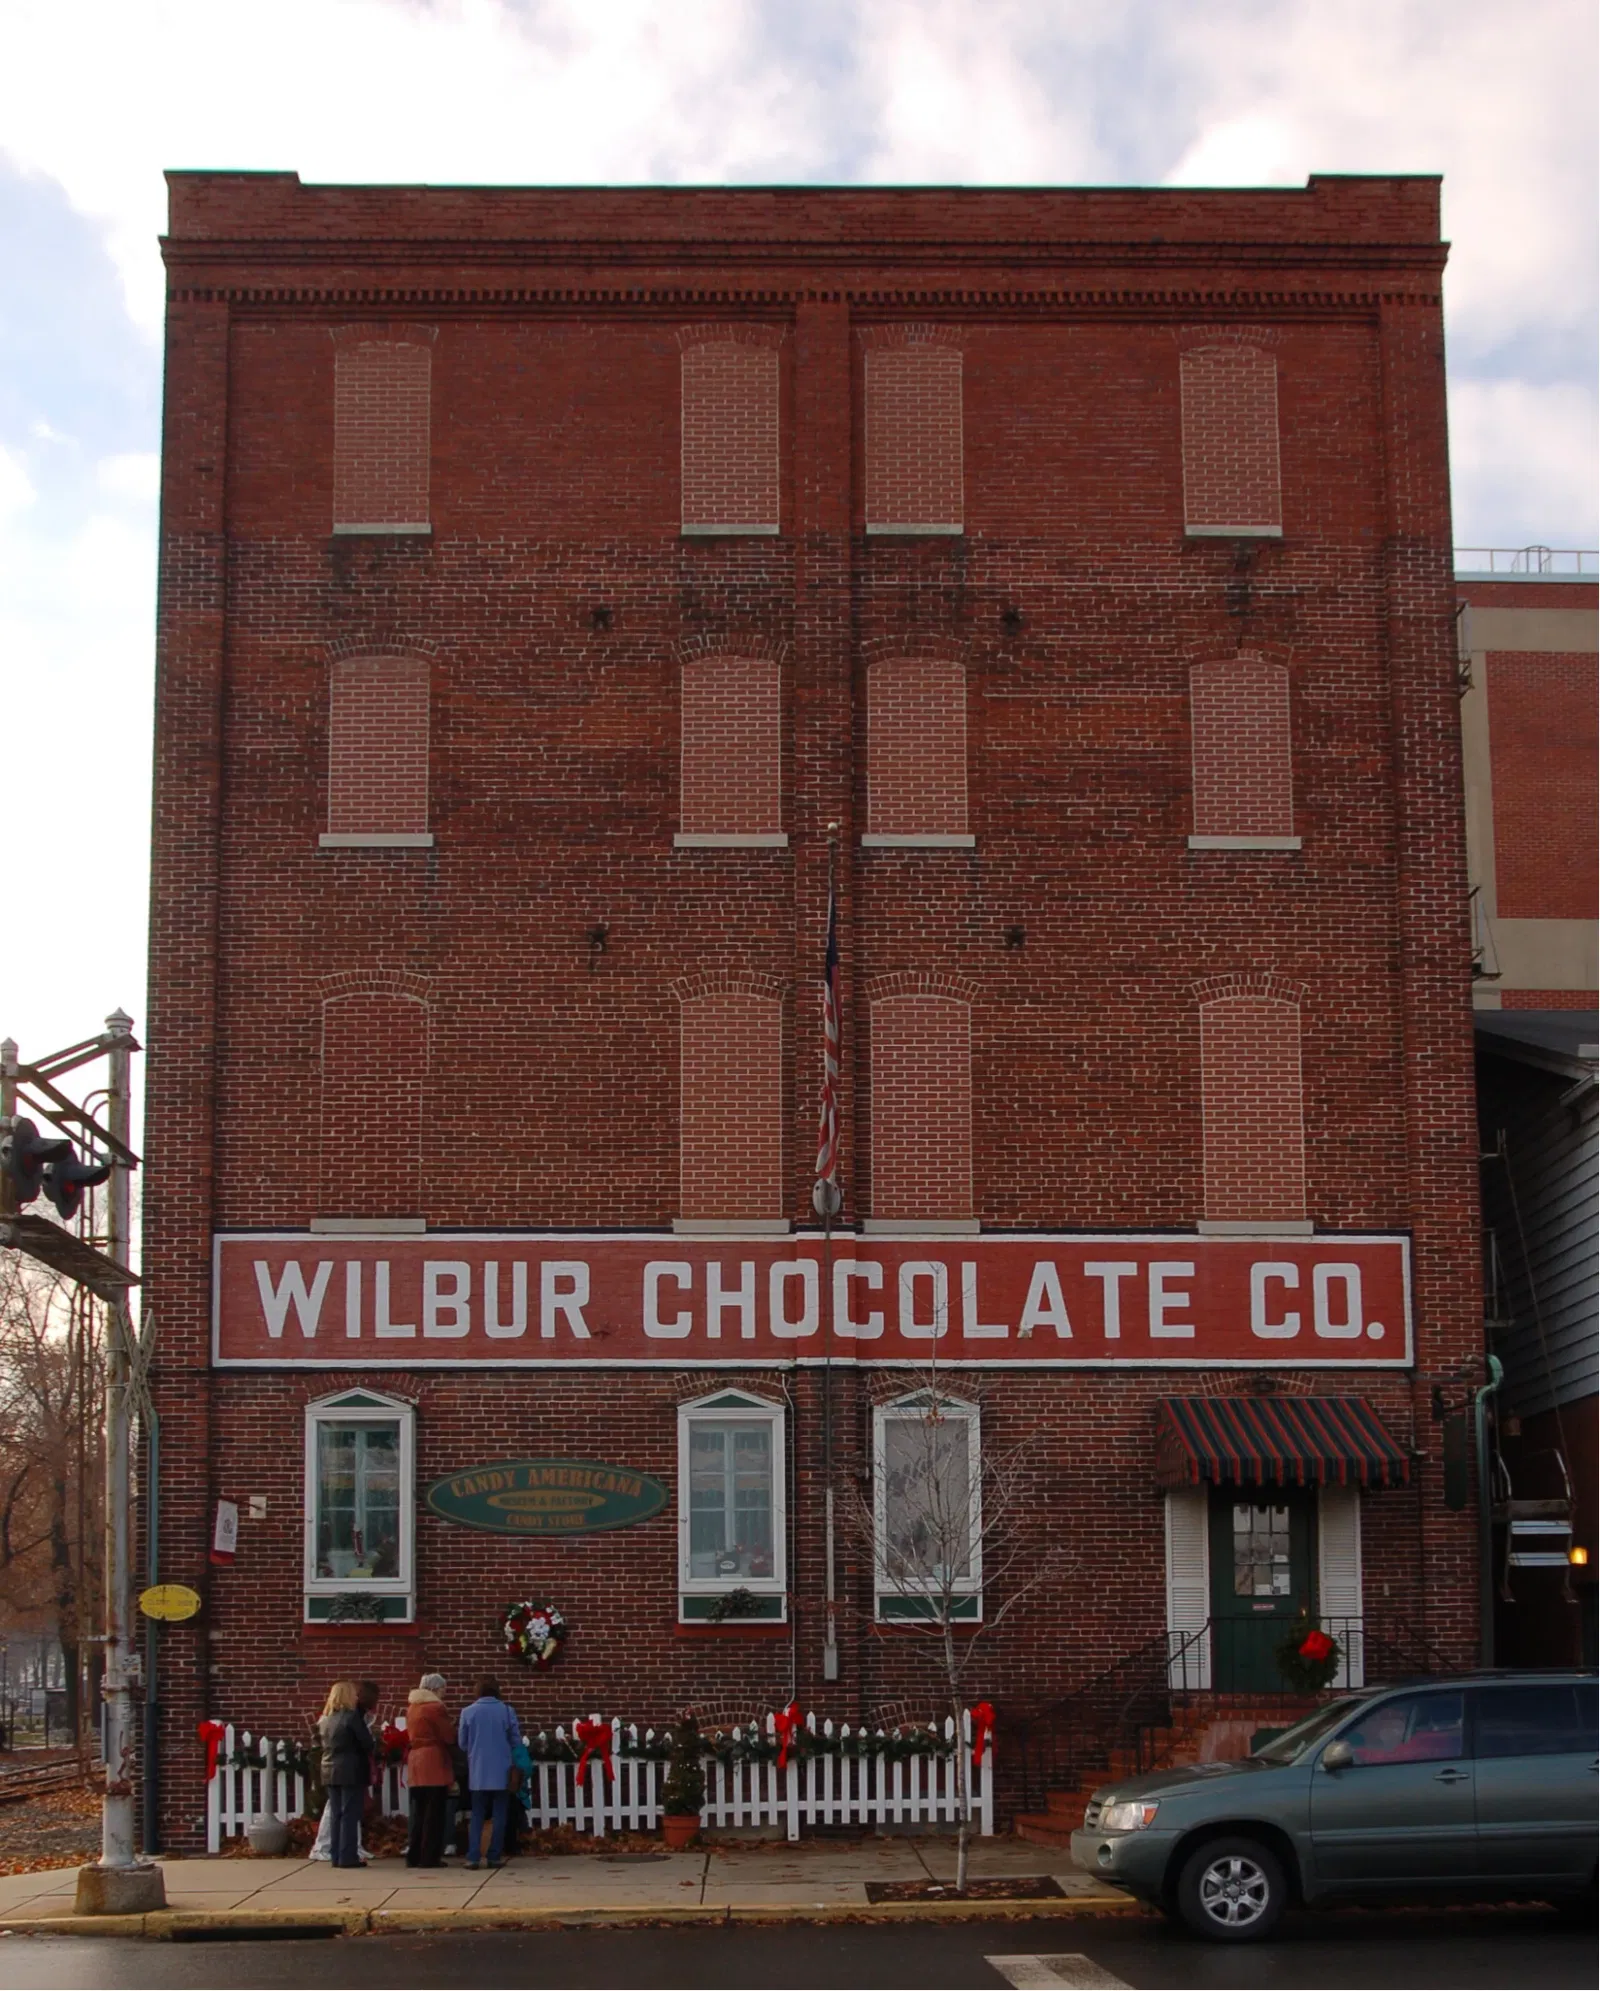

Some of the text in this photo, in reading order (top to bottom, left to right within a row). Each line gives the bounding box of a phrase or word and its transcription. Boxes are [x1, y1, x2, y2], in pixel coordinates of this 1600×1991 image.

[254, 1257, 1386, 1340] WILBUR CHOCOLATE CO.
[450, 1467, 643, 1498] CANDY AMERICANA
[506, 1513, 586, 1527] CANDY STORE
